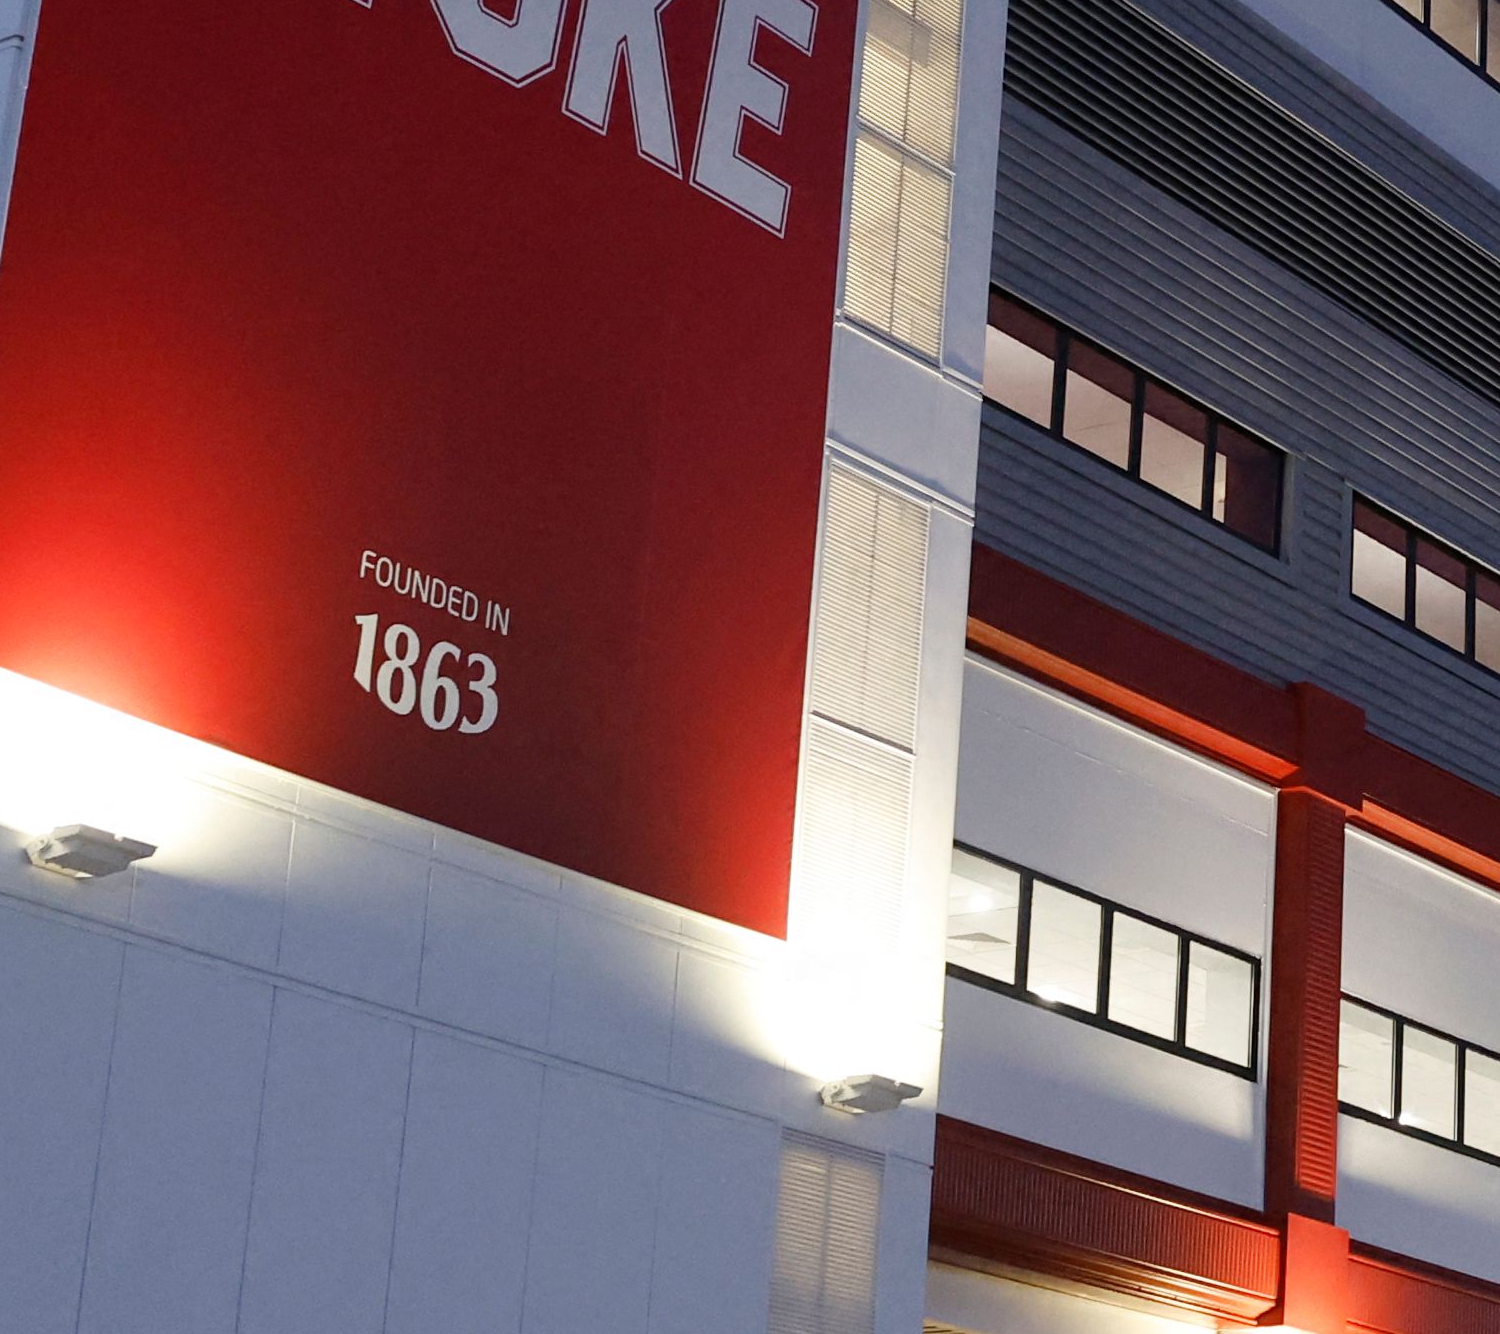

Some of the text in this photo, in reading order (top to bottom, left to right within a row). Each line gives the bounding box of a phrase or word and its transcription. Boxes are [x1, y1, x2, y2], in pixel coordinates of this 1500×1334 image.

[359, 549, 510, 636] FOUNDED IN
[353, 613, 499, 734] 1863
